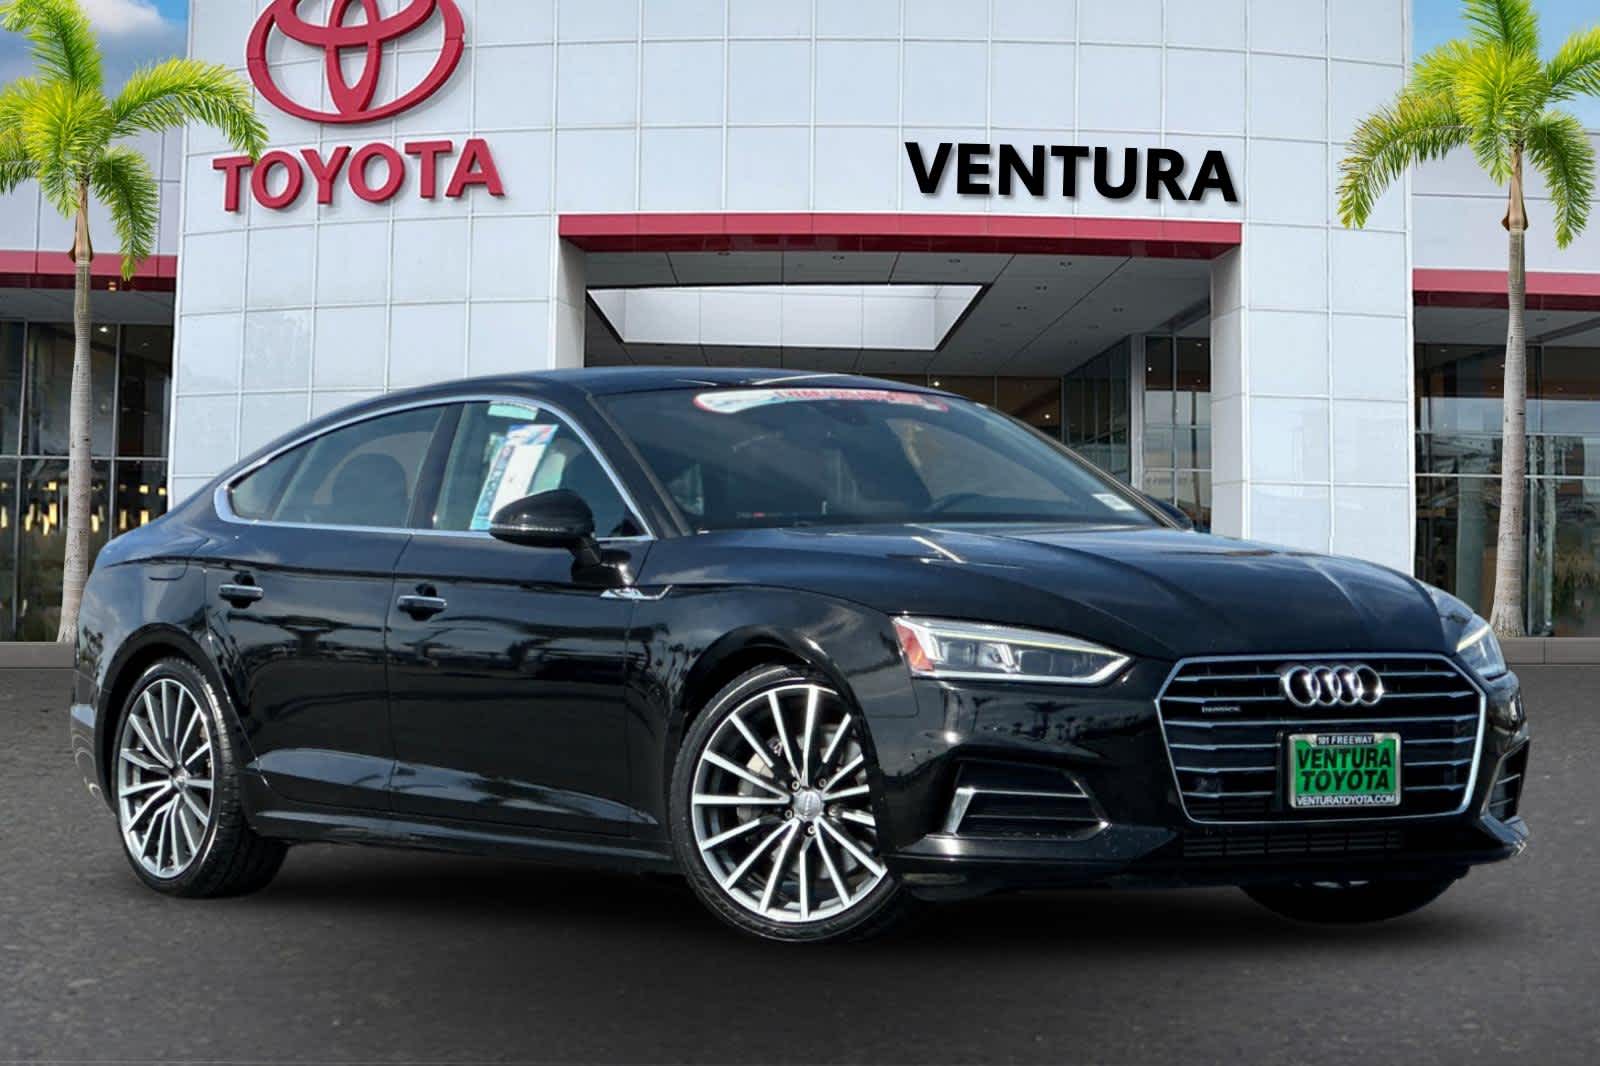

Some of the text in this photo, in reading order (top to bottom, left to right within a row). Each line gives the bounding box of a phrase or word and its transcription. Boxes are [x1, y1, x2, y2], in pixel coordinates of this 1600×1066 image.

[213, 138, 505, 212] TOYOTA
[905, 141, 1238, 202] VENTURA
[1331, 735, 1373, 745] FREEWAY
[1297, 747, 1392, 769] VENTURA
[1301, 769, 1389, 791] TOYOTA
[1297, 795, 1395, 806] VENTURATOYOTA.COM
